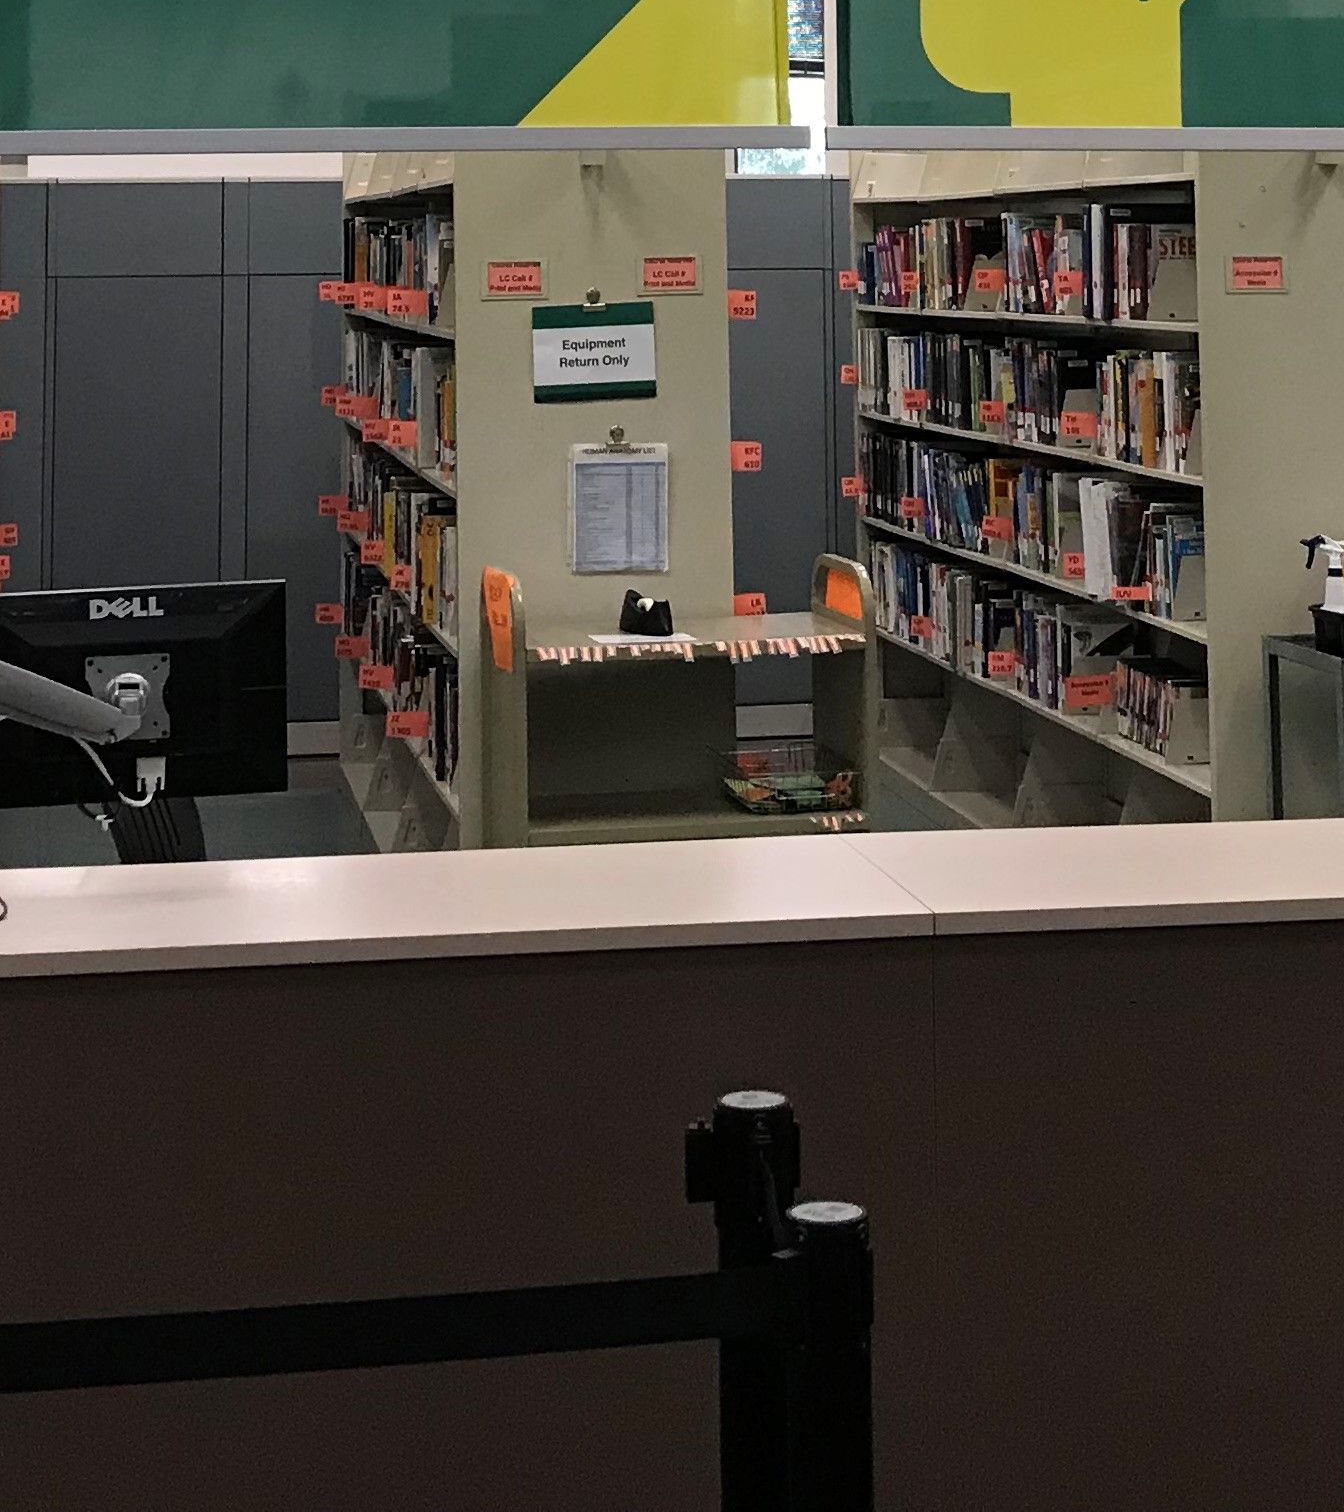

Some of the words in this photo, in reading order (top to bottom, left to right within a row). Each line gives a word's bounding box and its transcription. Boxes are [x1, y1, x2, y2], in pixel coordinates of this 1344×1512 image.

[562, 338, 626, 352] Equipment
[559, 356, 599, 368] Return
[602, 355, 630, 368] Only
[89, 596, 164, 620] DELL
